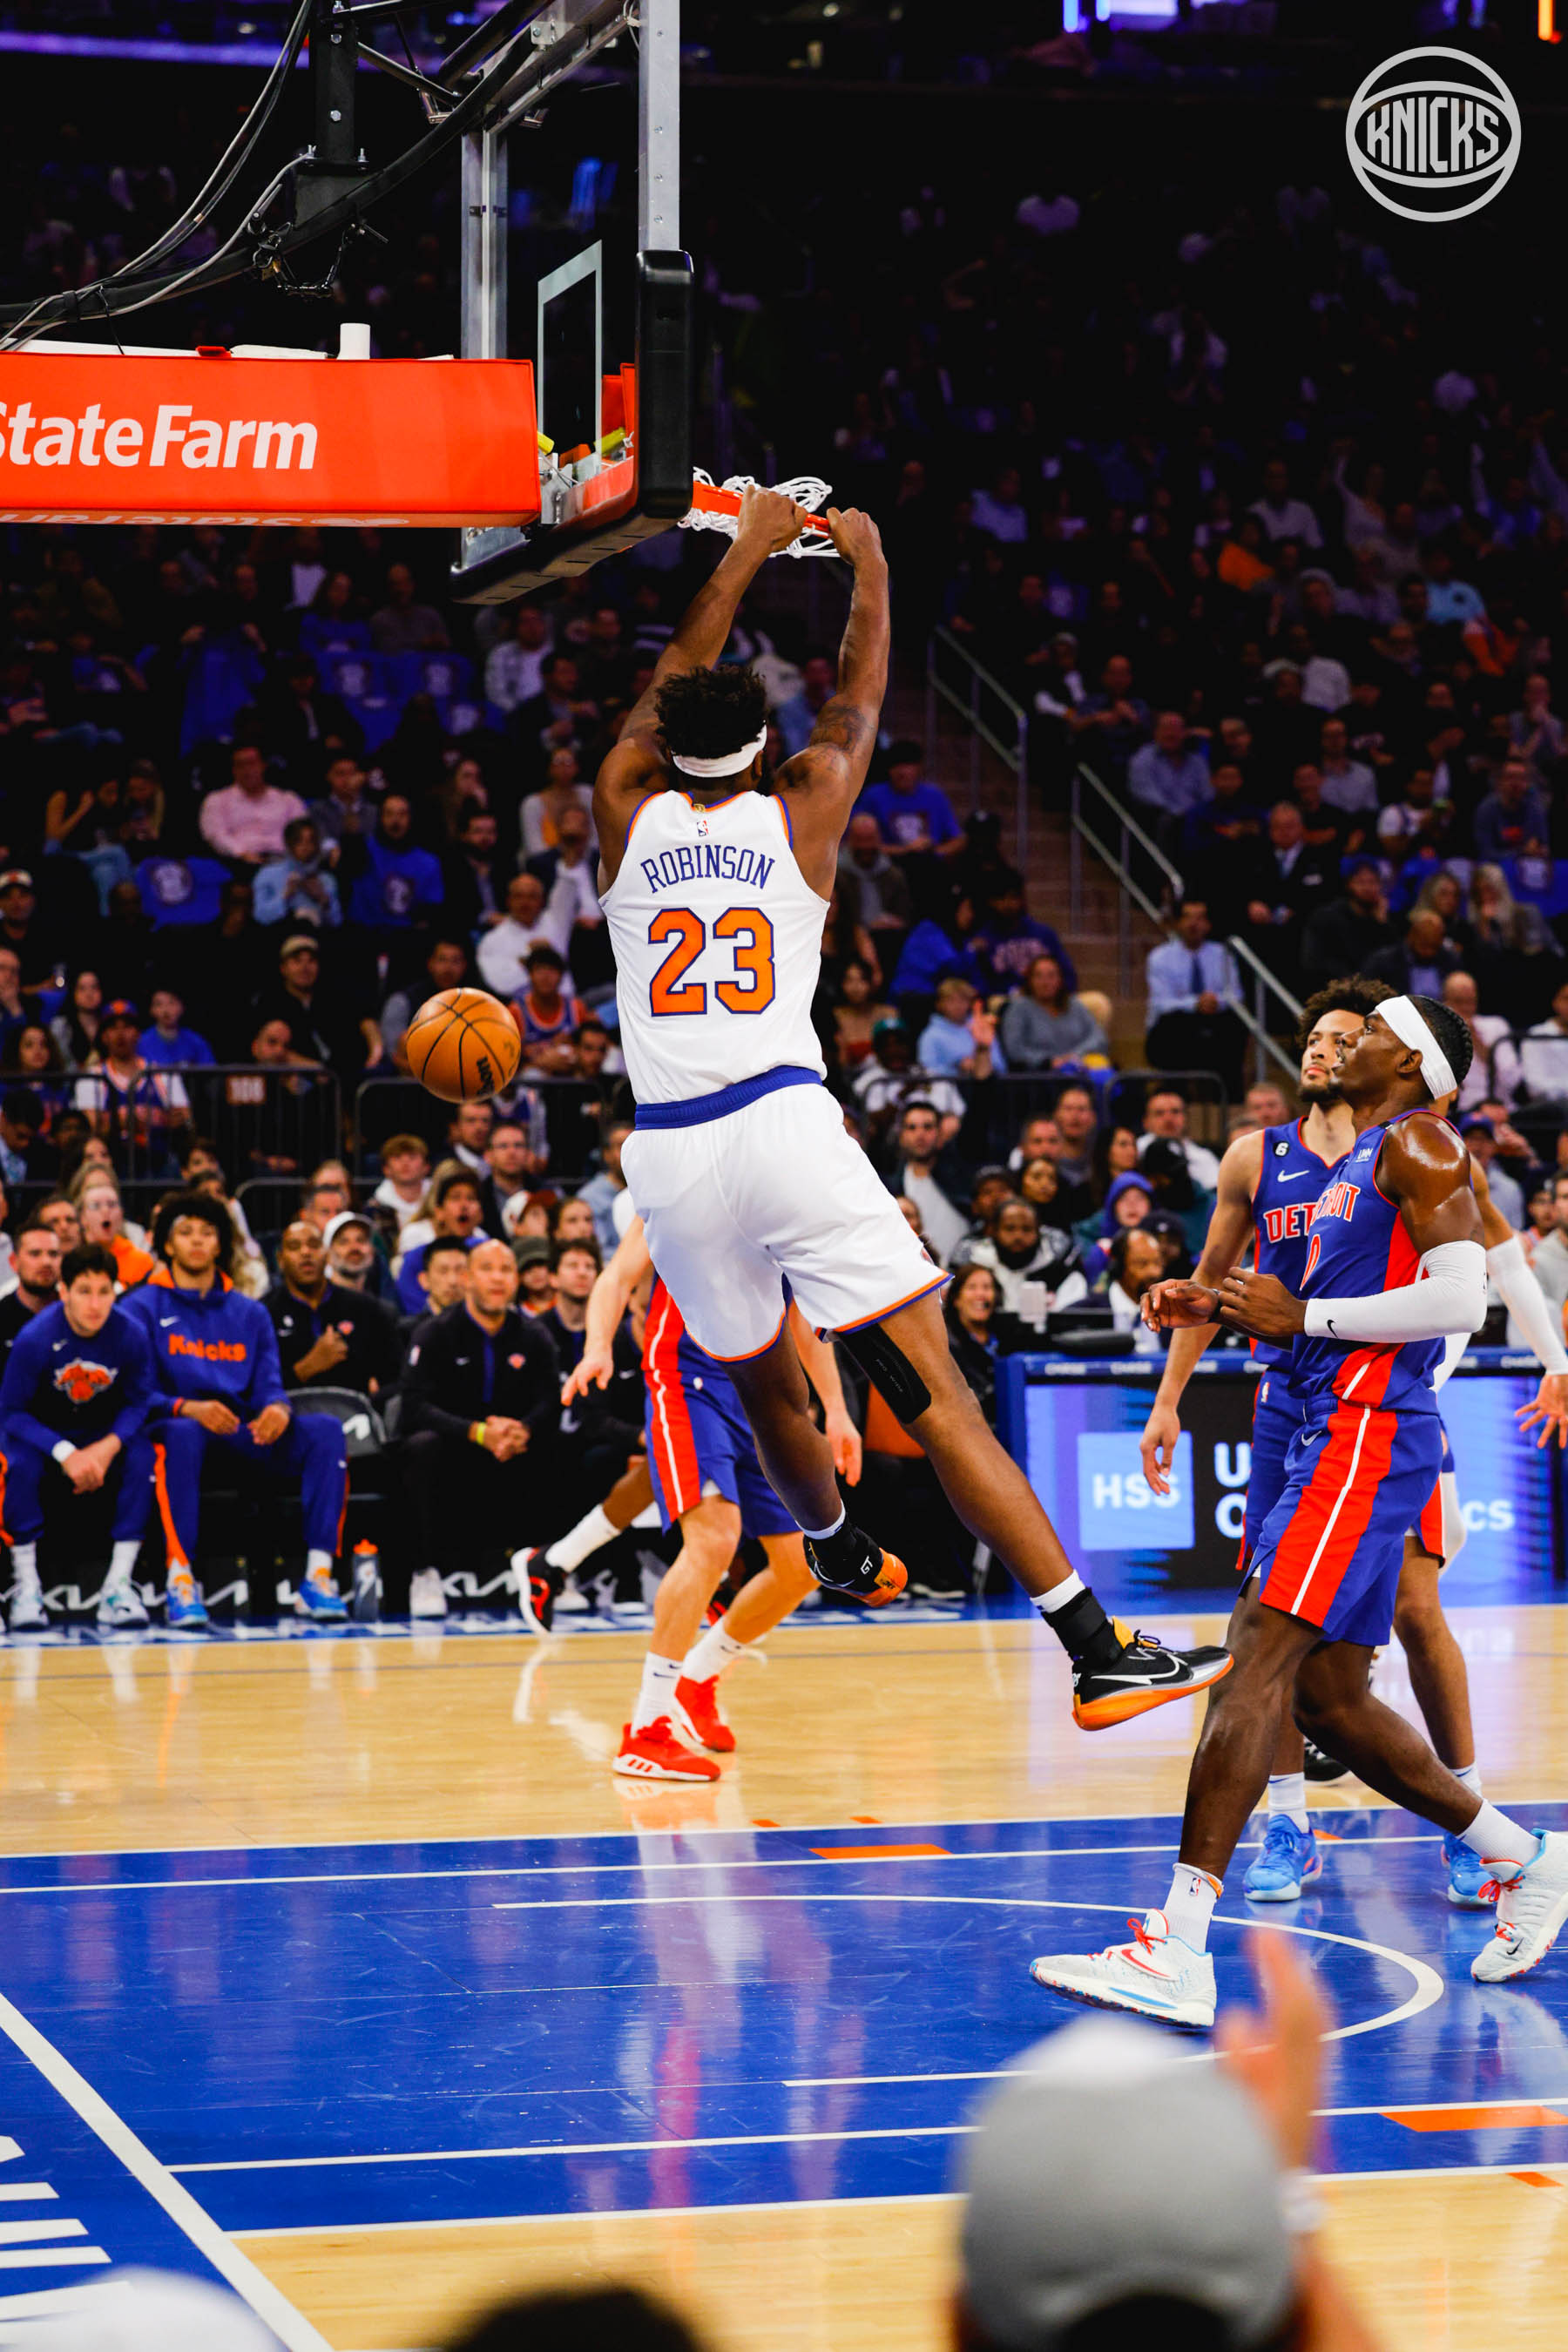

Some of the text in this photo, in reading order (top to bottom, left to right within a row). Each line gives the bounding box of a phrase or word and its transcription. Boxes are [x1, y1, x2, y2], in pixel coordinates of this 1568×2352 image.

[149, 404, 318, 470] Farm
[640, 844, 775, 894] ROBINSON
[647, 906, 776, 1017] 23
[1274, 1142, 1289, 1157] 6
[168, 1333, 247, 1362] Knicks
[1092, 1472, 1180, 1509] HSS
